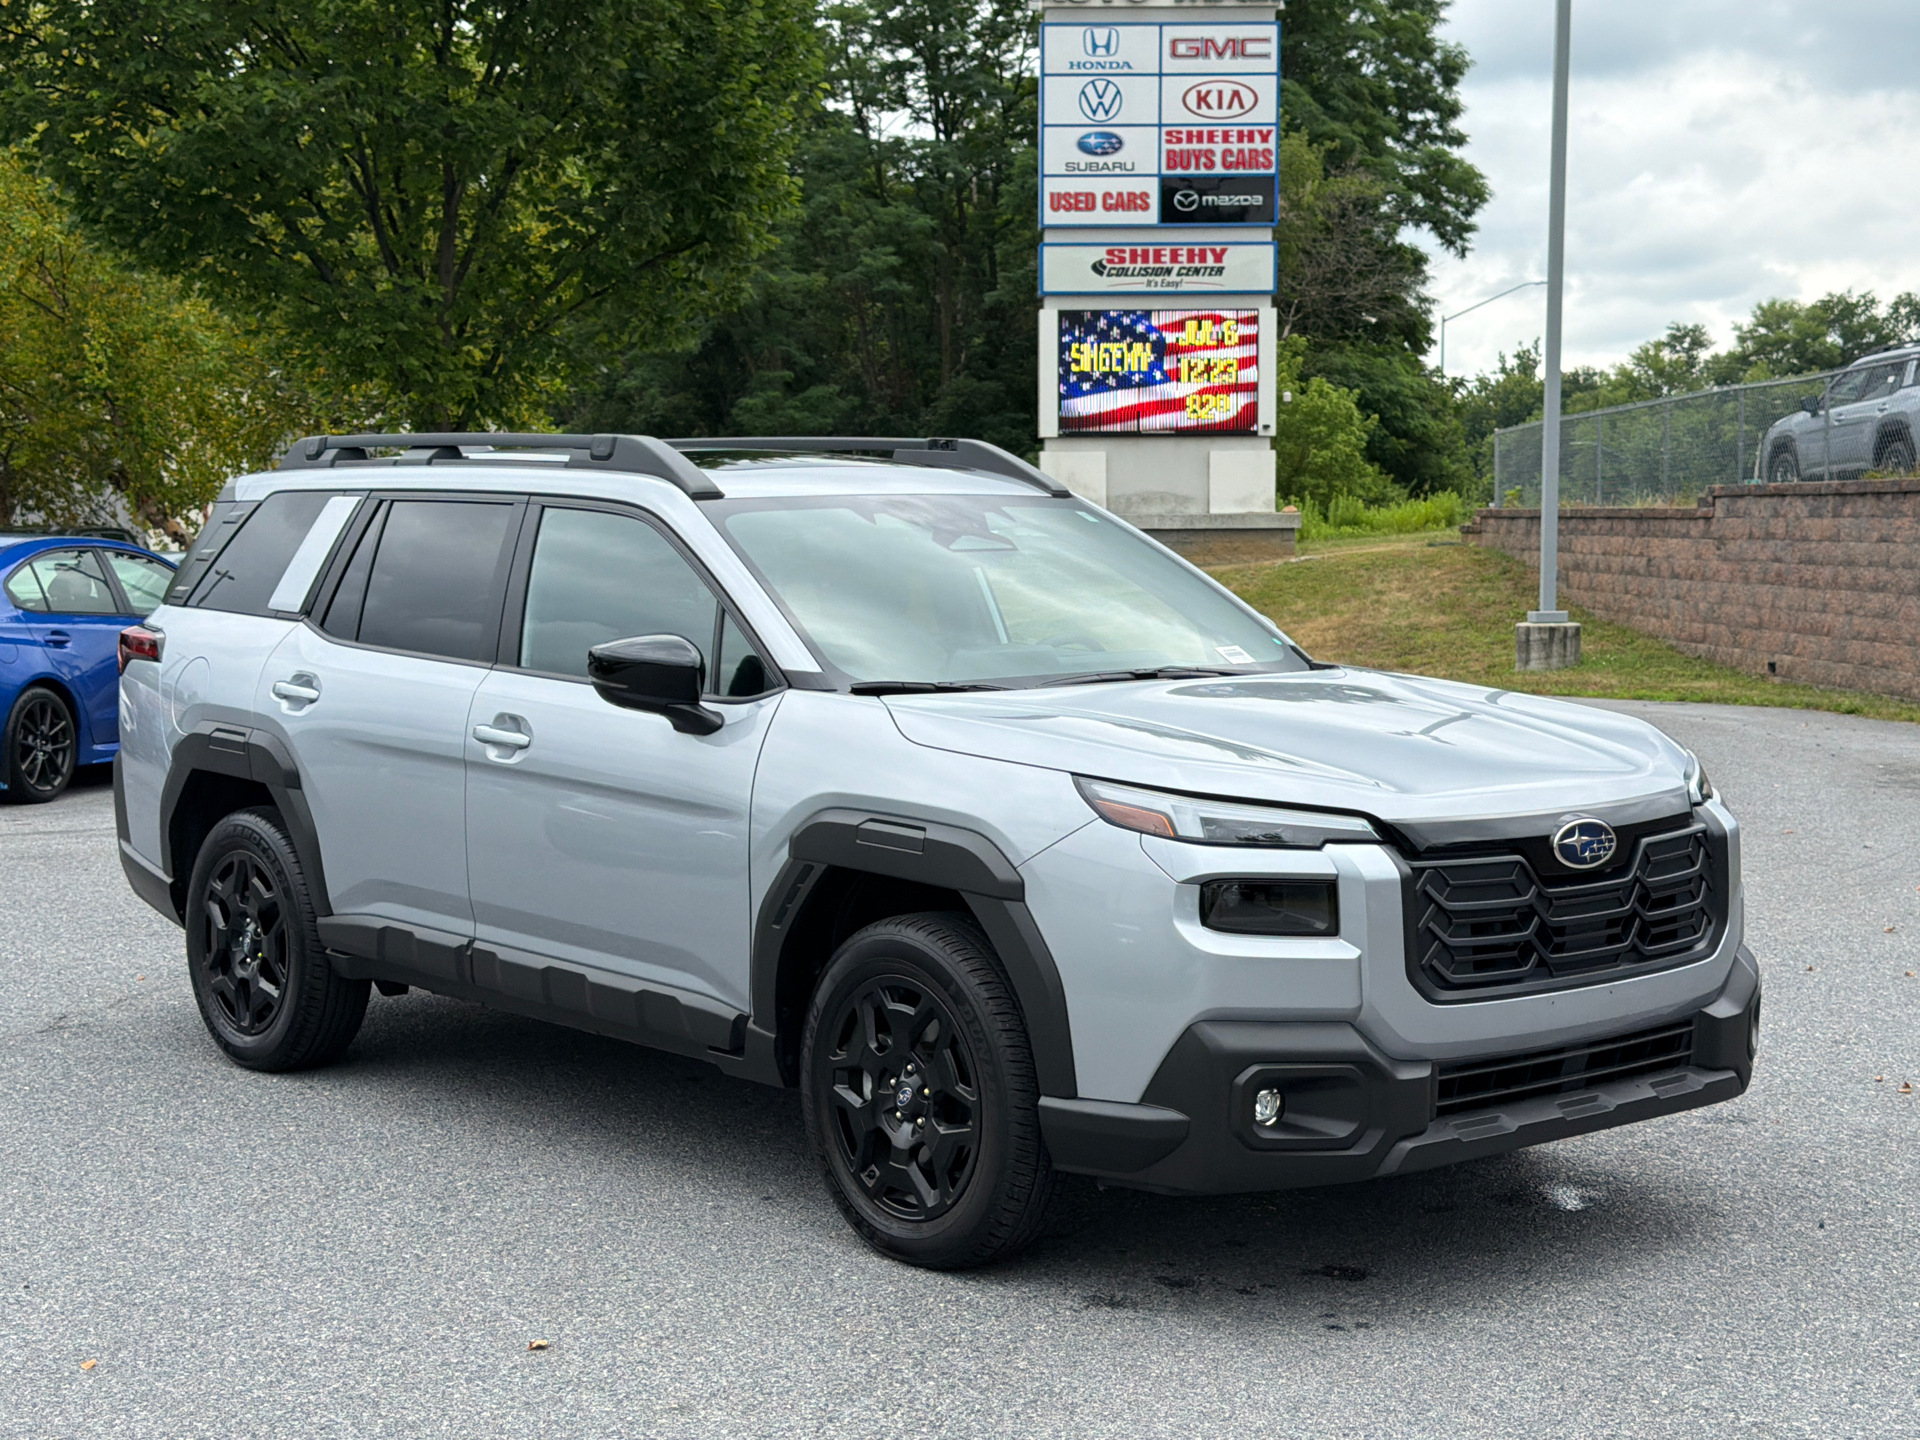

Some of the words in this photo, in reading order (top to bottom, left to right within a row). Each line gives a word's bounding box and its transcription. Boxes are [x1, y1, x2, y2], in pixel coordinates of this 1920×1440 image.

[1170, 37, 1271, 59] GMC
[1068, 61, 1133, 70] HONDA
[1196, 90, 1245, 110] KIA
[1165, 130, 1273, 144] SHEEHY
[1166, 148, 1215, 170] BUYS
[1221, 147, 1274, 170] CARS
[1064, 161, 1135, 172] SUBARU
[1049, 192, 1096, 212] USED
[1102, 191, 1150, 212] CARS
[1201, 194, 1263, 206] mazda
[1105, 248, 1229, 265] SHEEHY
[1106, 266, 1172, 278] COLLISION
[1176, 266, 1226, 277] CENTER
[1146, 278, 1158, 288] It's
[1160, 278, 1183, 290] Easy!
[1070, 342, 1152, 373] SHEEHY
